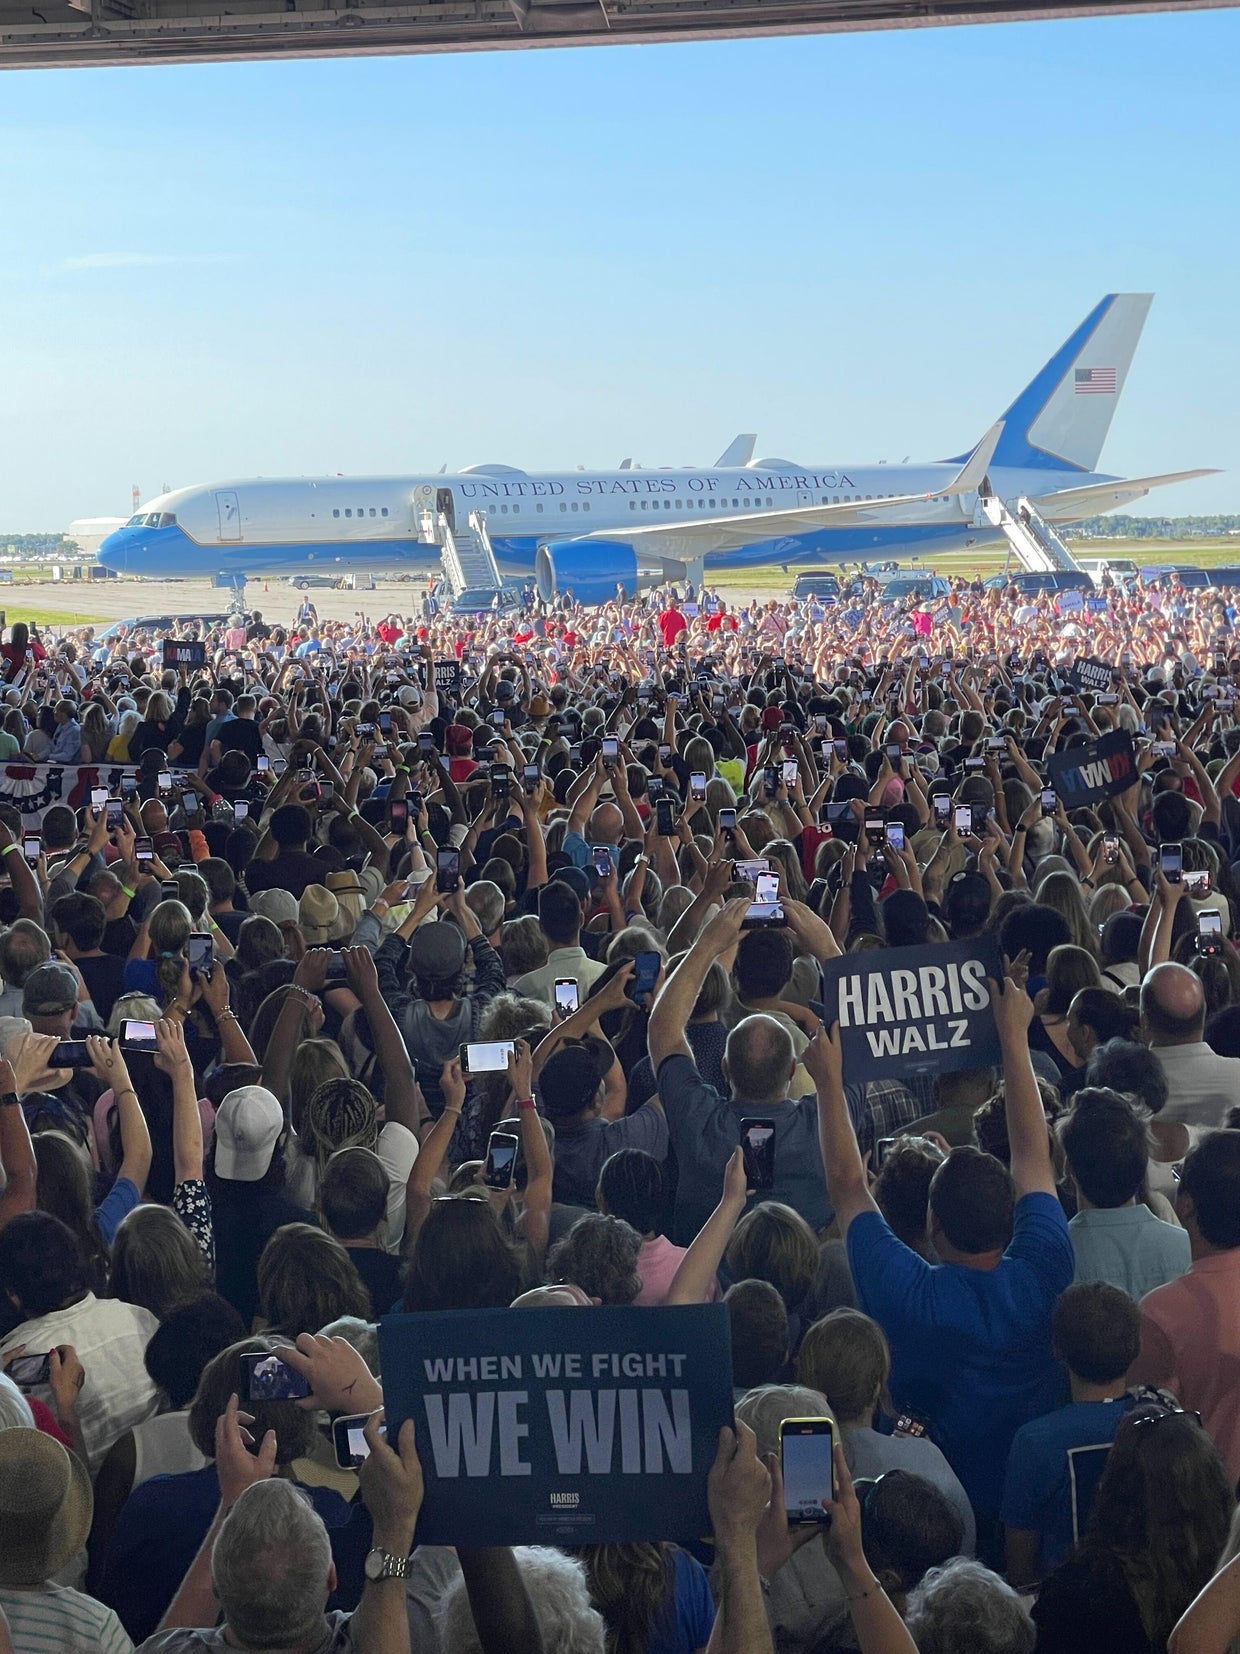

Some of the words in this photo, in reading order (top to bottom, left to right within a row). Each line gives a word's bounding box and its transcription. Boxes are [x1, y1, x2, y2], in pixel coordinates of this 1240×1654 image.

[461, 481, 564, 498] UNITED
[577, 479, 676, 495] STATES
[688, 478, 719, 492] OF
[736, 475, 856, 491] AMERICA
[423, 666, 455, 678] HRRIS
[838, 960, 990, 1027] HARRIS
[866, 1019, 971, 1058] WALZ
[424, 1355, 522, 1382] WHEN
[532, 1354, 582, 1378] WE
[592, 1353, 687, 1378] FIGHT
[423, 1391, 532, 1478] WE
[546, 1389, 692, 1475] WIN
[550, 1493, 580, 1504] HARRIS
